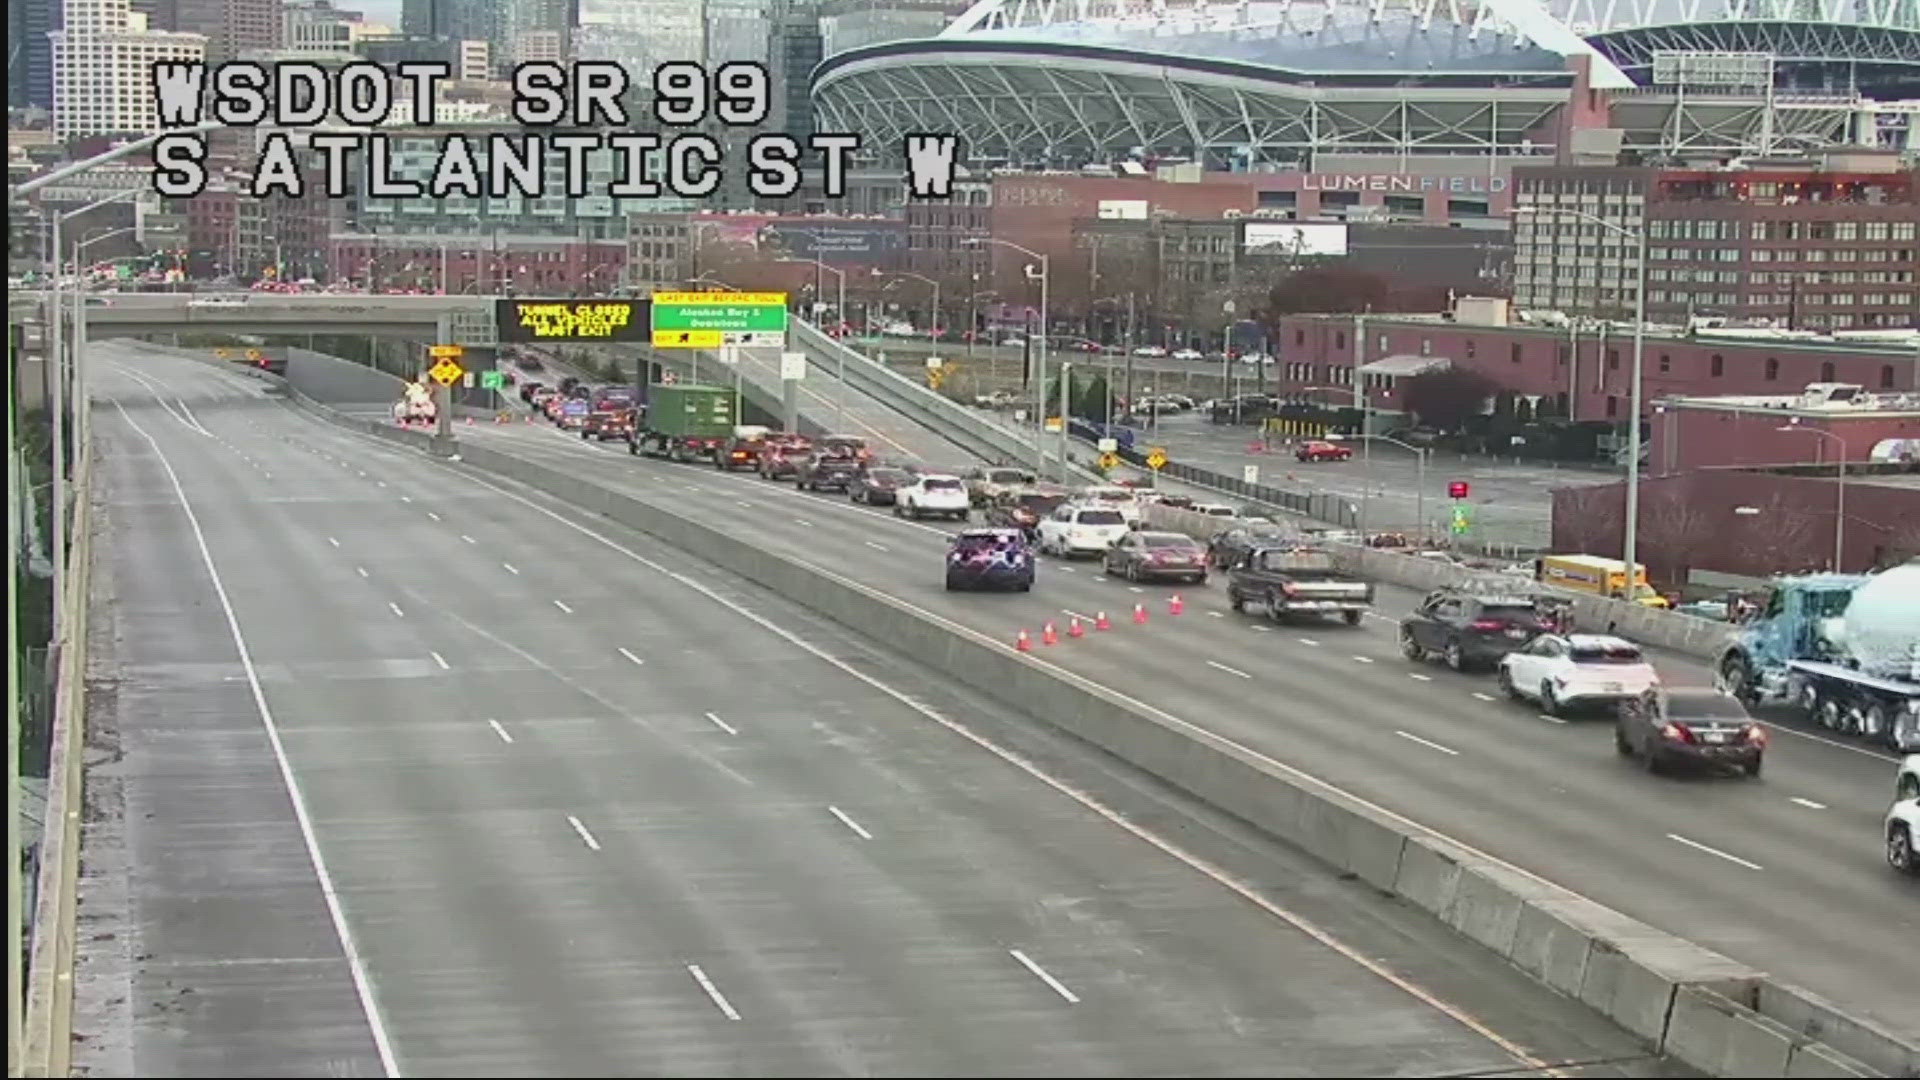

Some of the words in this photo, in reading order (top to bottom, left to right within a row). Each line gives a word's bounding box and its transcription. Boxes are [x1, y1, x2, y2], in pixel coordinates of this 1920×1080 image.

[1303, 175, 1411, 190] LUMEN
[1420, 177, 1506, 192] FIELD
[660, 294, 684, 302] LAST
[688, 294, 708, 302] EXIT
[713, 294, 751, 302] BEFORE
[754, 294, 777, 302] TOLL
[517, 304, 570, 315] TUNNEL
[575, 304, 630, 315] CLOSED
[520, 315, 552, 325] ALL
[555, 315, 628, 325] VEHICLES
[535, 326, 571, 336] MUST
[578, 326, 611, 336] EXIT
